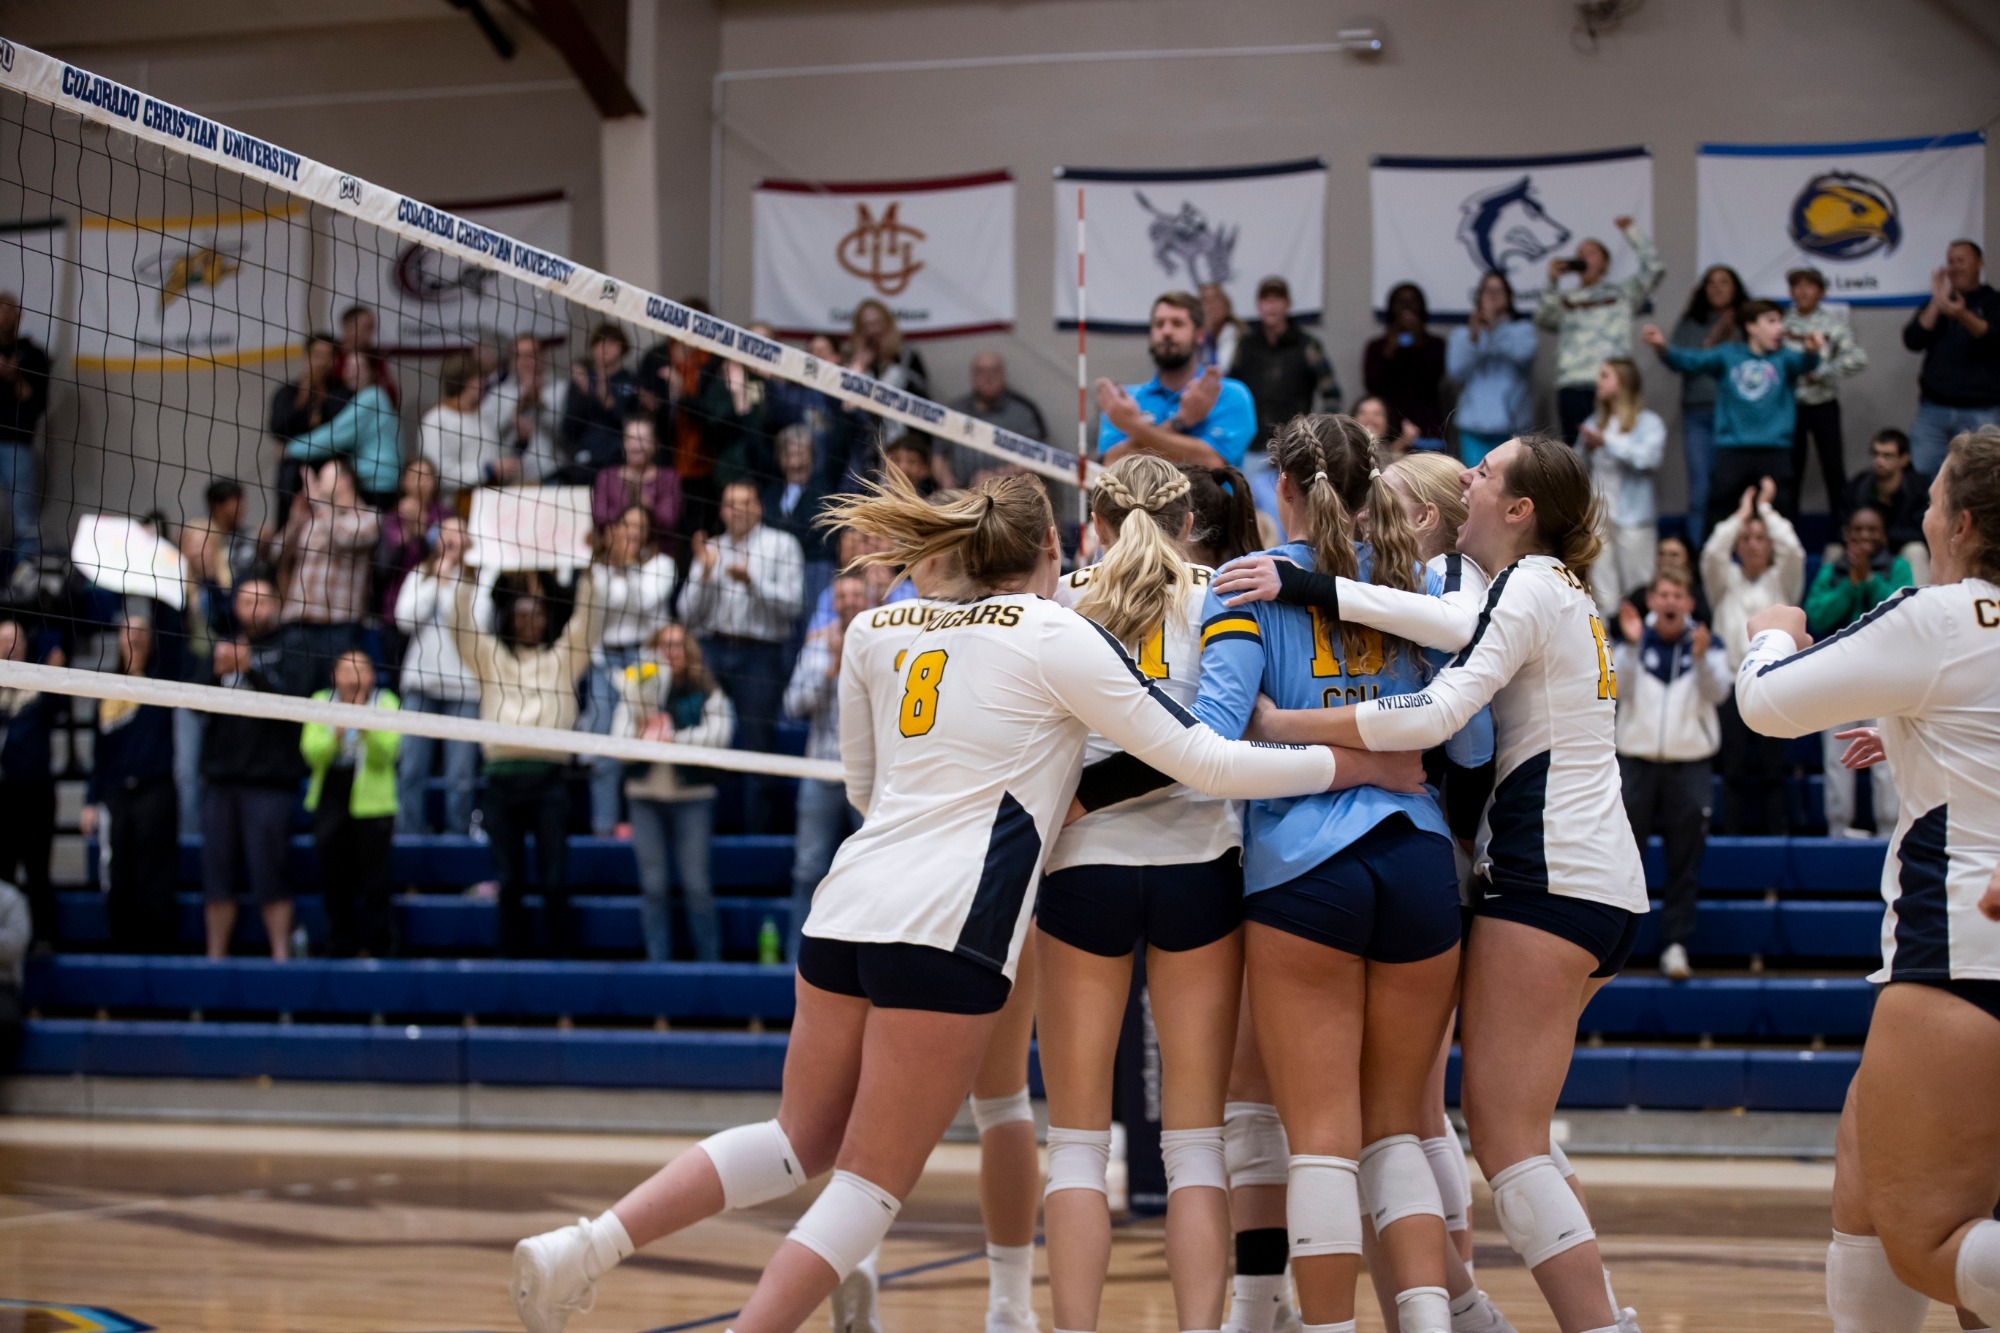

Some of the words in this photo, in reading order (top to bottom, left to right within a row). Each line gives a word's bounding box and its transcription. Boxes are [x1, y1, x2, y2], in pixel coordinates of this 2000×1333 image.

[62, 65, 140, 121] COLORADO
[142, 98, 219, 151] CHRISTIAN
[222, 128, 301, 182] UNIVERSITY
[339, 175, 362, 206] CCU
[397, 197, 455, 240] COLORADO
[456, 220, 512, 263] CHRISTIAN
[514, 243, 576, 286] UNIVERSITY
[899, 648, 949, 738] 8
[1378, 693, 1433, 711] CHRISTIAN
